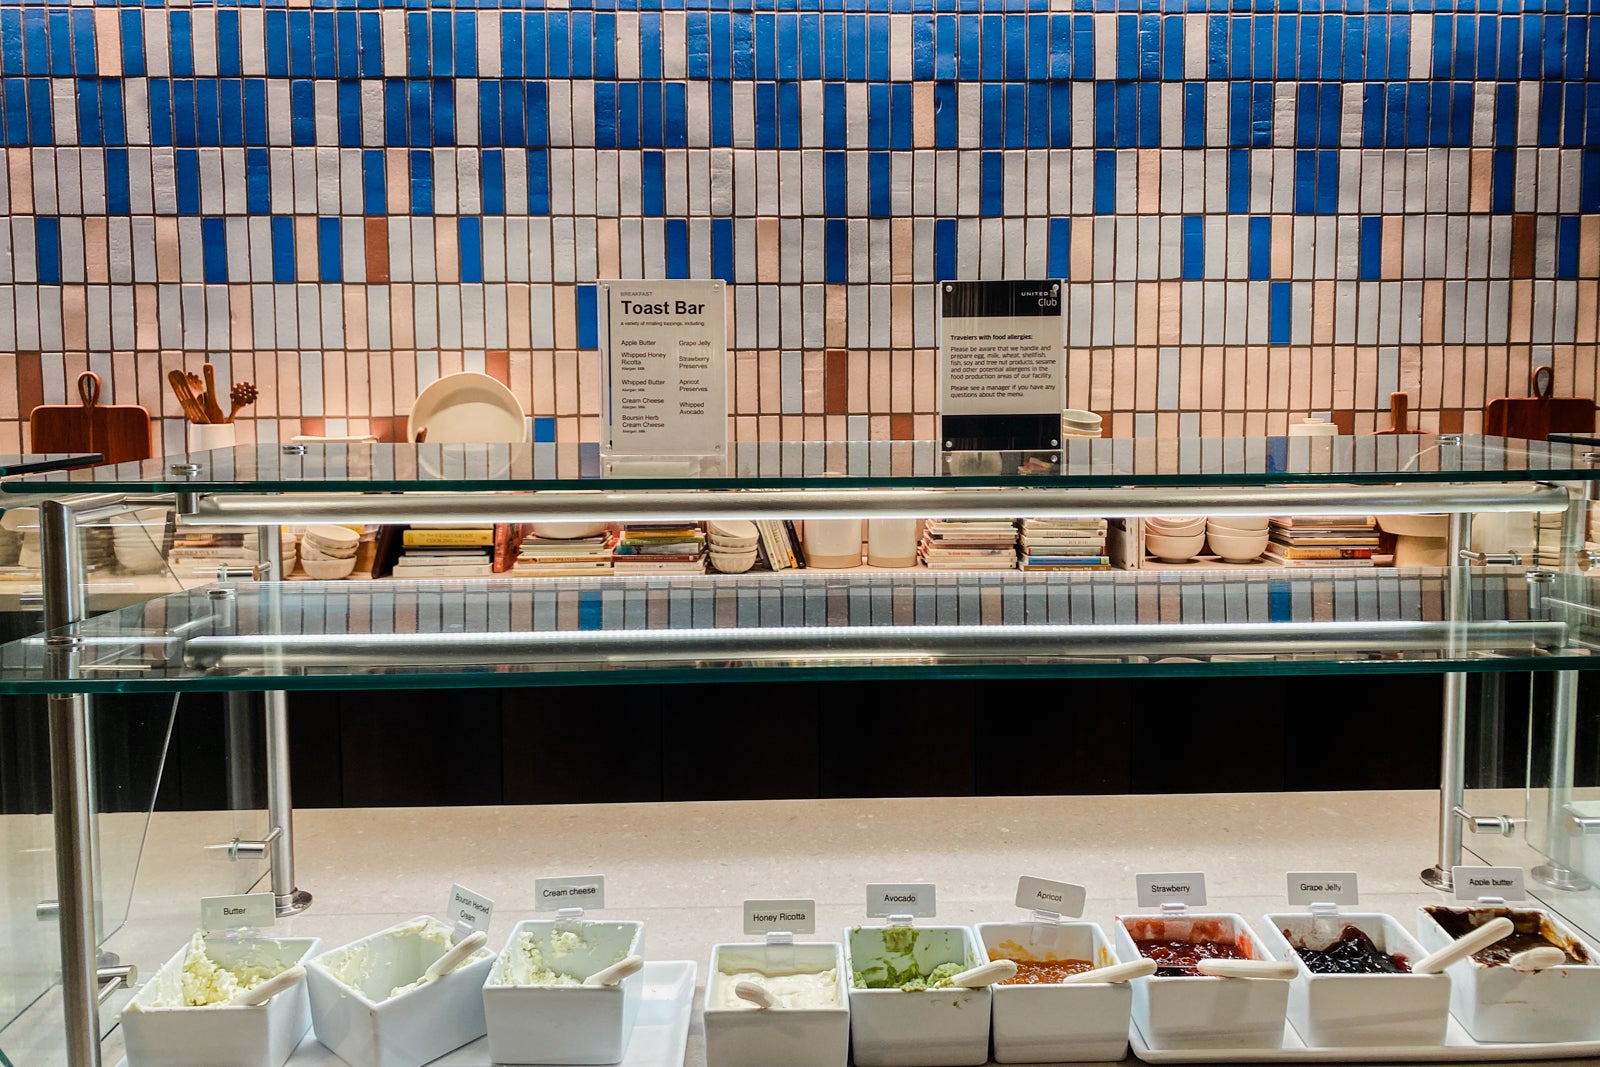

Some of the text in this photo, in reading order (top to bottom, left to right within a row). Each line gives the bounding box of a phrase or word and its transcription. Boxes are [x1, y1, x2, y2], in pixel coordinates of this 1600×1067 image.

[1038, 298, 1057, 306] Club
[621, 301, 705, 314] Toast Bar
[1152, 884, 1190, 893] Strawberry
[1325, 883, 1341, 891] Jelly
[884, 894, 916, 903] Avocado
[1036, 891, 1062, 901] Apricot
[223, 906, 246, 915] Butter
[472, 900, 490, 914] Herbed
[460, 910, 475, 922] Cream
[753, 914, 777, 922] Honey
